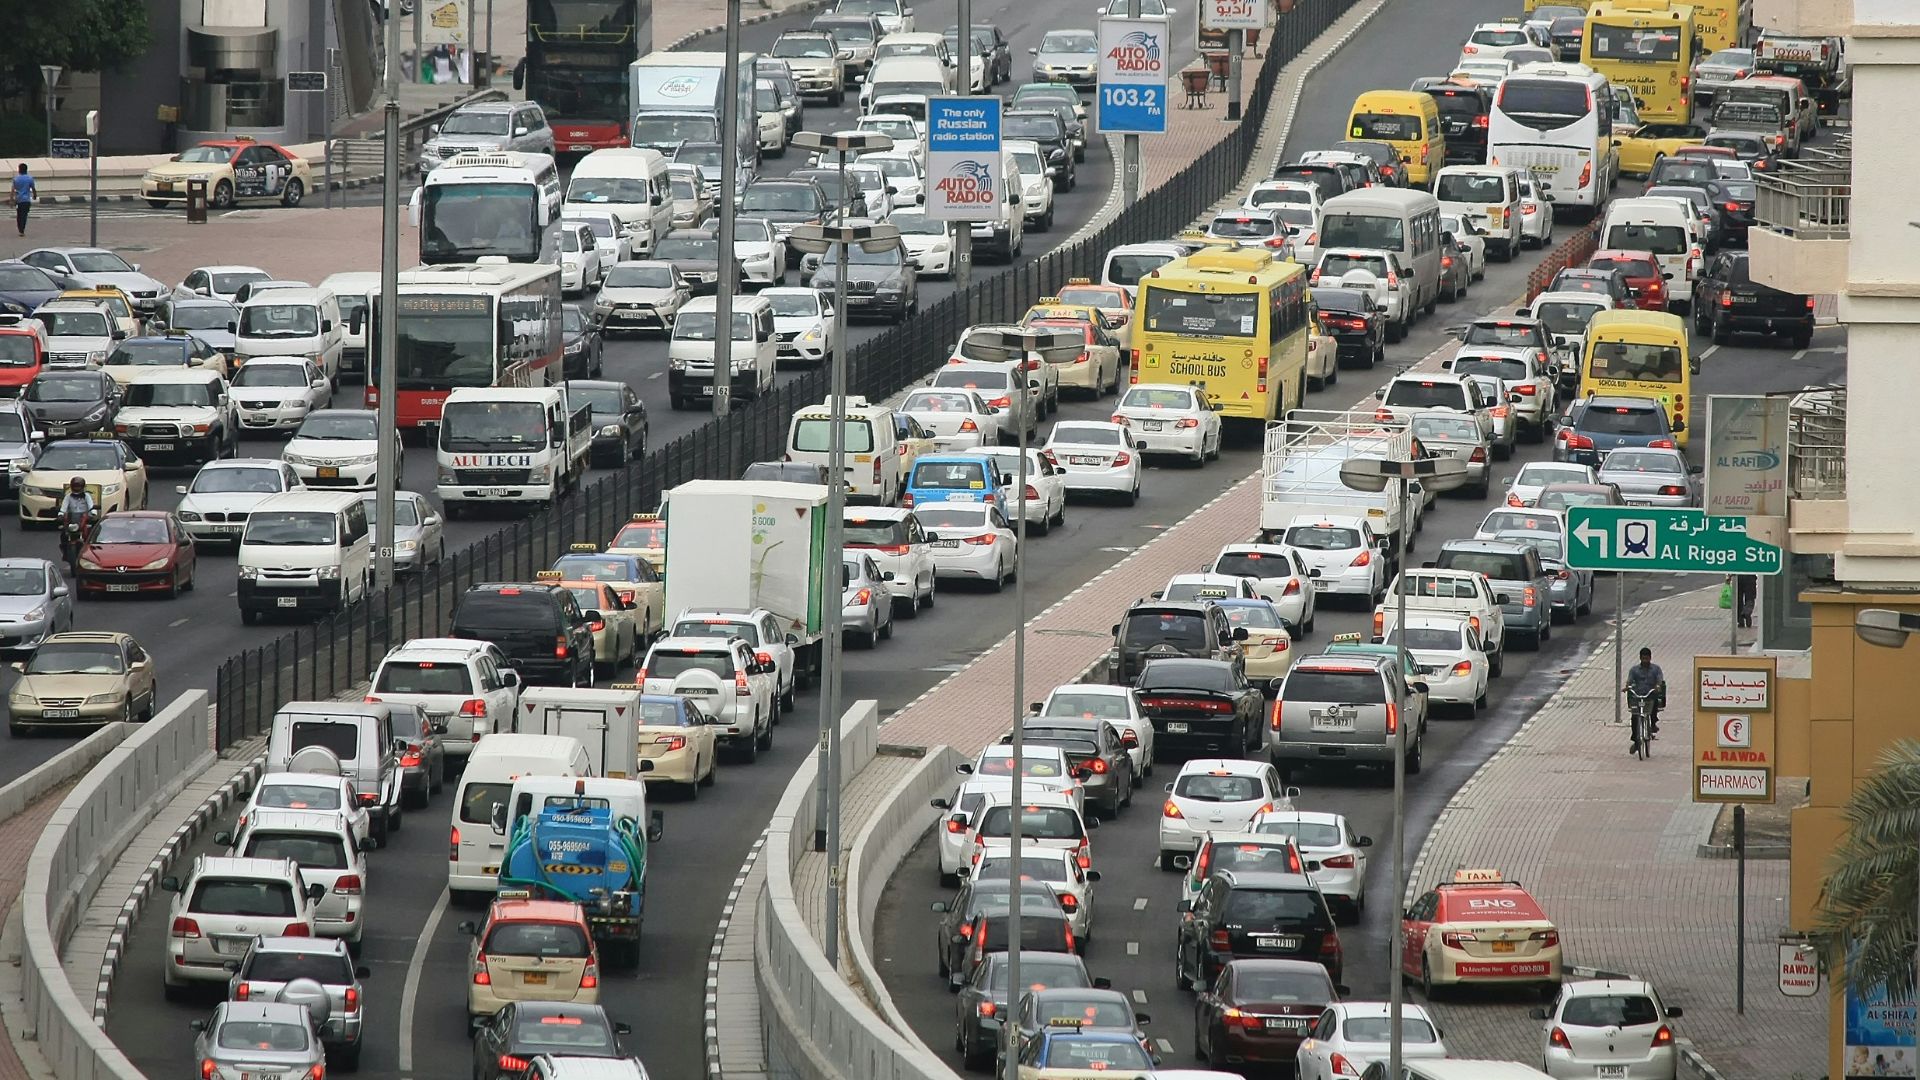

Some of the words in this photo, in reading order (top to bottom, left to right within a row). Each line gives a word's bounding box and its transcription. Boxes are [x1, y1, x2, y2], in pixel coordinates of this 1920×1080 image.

[1216, 3, 1252, 17] راديو
[1697, 24, 1717, 33] Bus
[1107, 47, 1145, 59] AUTO
[1772, 48, 1811, 57] TOYOTA
[1116, 59, 1160, 71] RADIO
[1641, 85, 1656, 94] BUS
[1104, 88, 1156, 106] 103.2
[942, 109, 961, 117] The
[963, 110, 985, 118] only
[1148, 107, 1160, 115] FM
[938, 119, 987, 129] Russian
[935, 178, 977, 191] AUTO
[946, 190, 994, 203] RADIO
[1172, 351, 1200, 362] مدرسية
[1202, 352, 1226, 362] حافلة
[1170, 362, 1205, 376] SCHOOL
[1208, 366, 1226, 377] BUS
[719, 387, 728, 396] 62
[452, 456, 482, 466] ALU
[485, 456, 530, 466] TECH
[1716, 457, 1730, 467] AL
[1712, 496, 1722, 504] AL
[1724, 496, 1750, 505] RAFID
[758, 517, 776, 526] GOOD
[1669, 516, 1710, 536] الرقة
[1718, 517, 1746, 532] طة
[382, 548, 392, 556] 63
[1661, 545, 1680, 560] Al
[1688, 546, 1736, 564] Rigga
[1745, 548, 1776, 563] Stn
[1702, 674, 1765, 690] صيدلية
[1704, 692, 1764, 704] الروضة
[1702, 751, 1716, 760] AL
[1720, 752, 1766, 762] RAWDA
[1702, 775, 1764, 789] PHARMACY
[1469, 900, 1516, 908] ENG
[1783, 964, 1815, 974] RAWDA
[1867, 1010, 1878, 1019] AL
[1882, 1010, 1909, 1020] SHIFA
